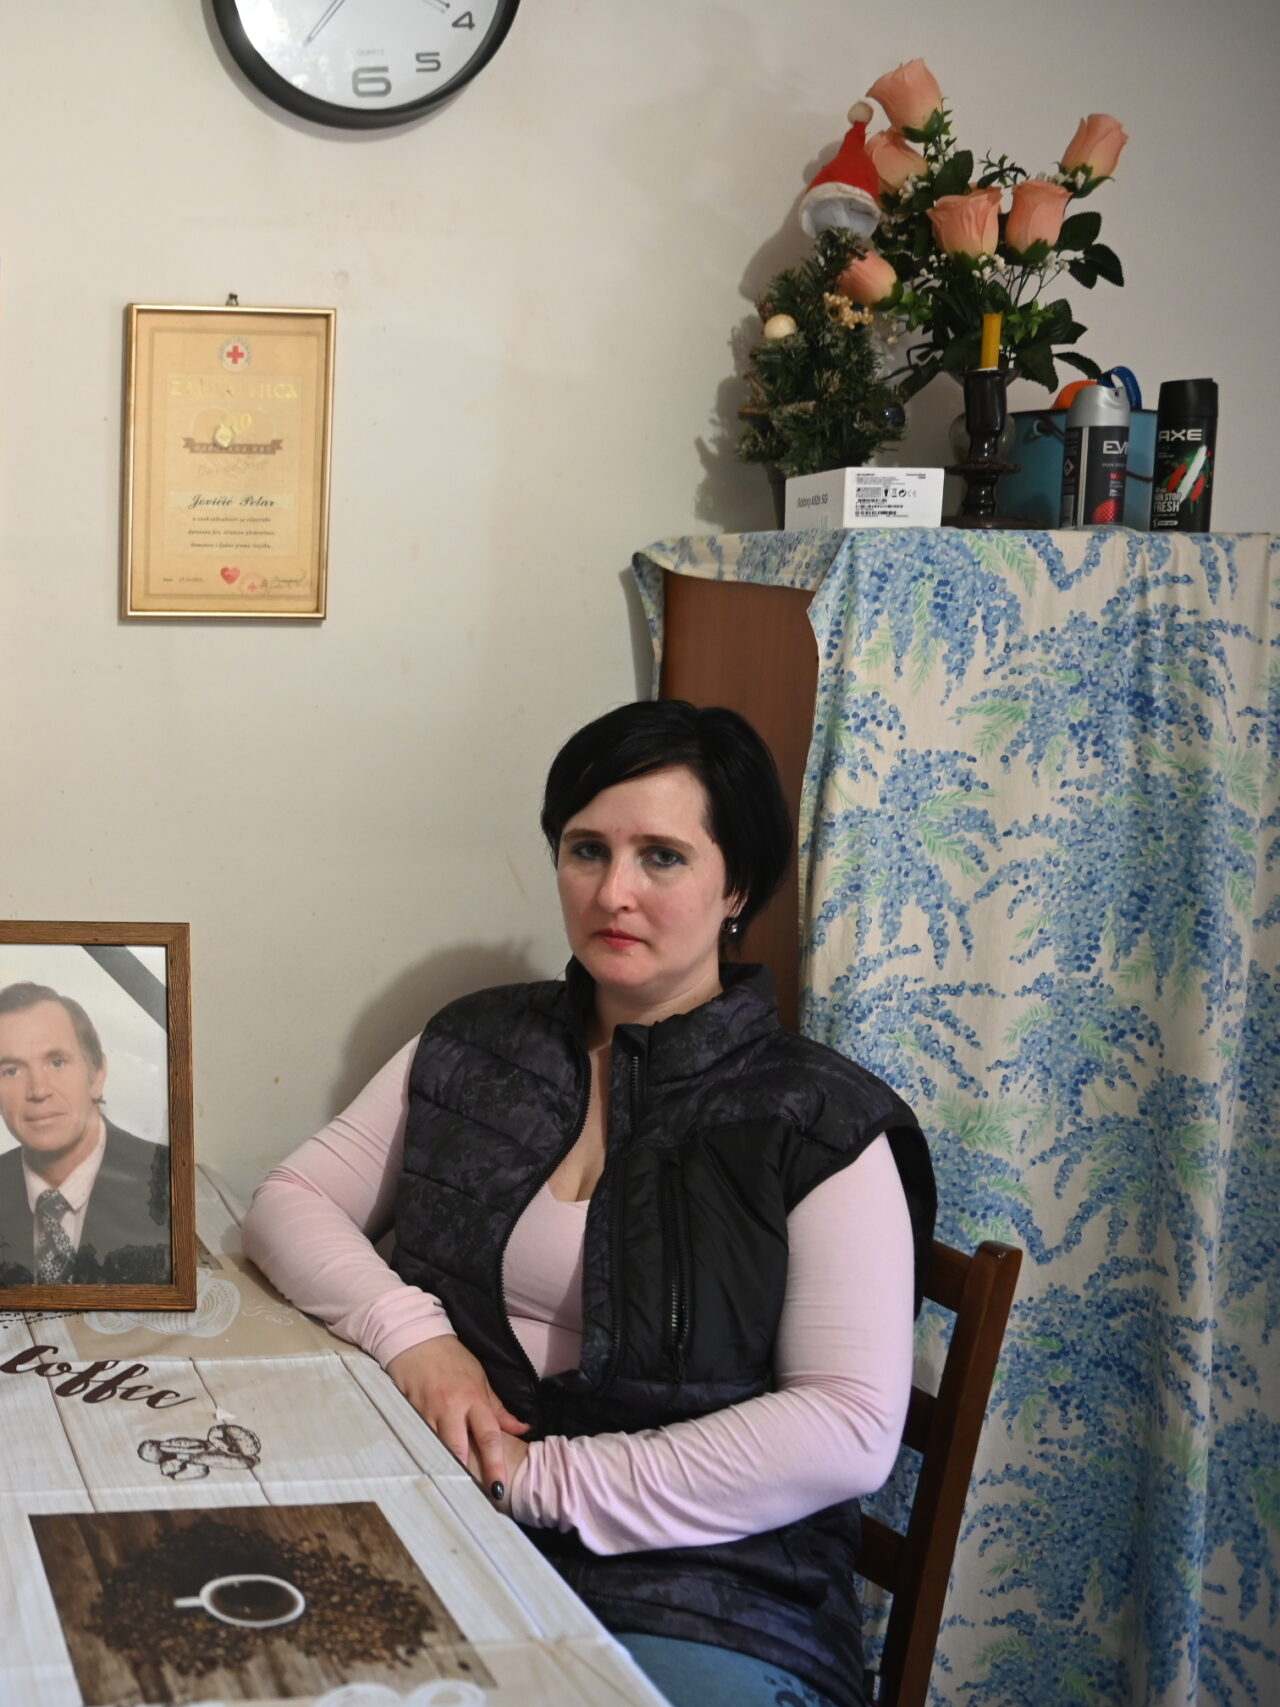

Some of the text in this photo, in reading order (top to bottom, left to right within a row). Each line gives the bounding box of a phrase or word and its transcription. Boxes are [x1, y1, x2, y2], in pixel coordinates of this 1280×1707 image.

[451, 11, 475, 30] 4
[415, 52, 441, 72] 5
[351, 66, 392, 98] 6
[1159, 428, 1202, 442] AXE
[1164, 492, 1182, 502] STOP
[1153, 501, 1180, 513] FRESH
[0, 1345, 198, 1409] Coffee
